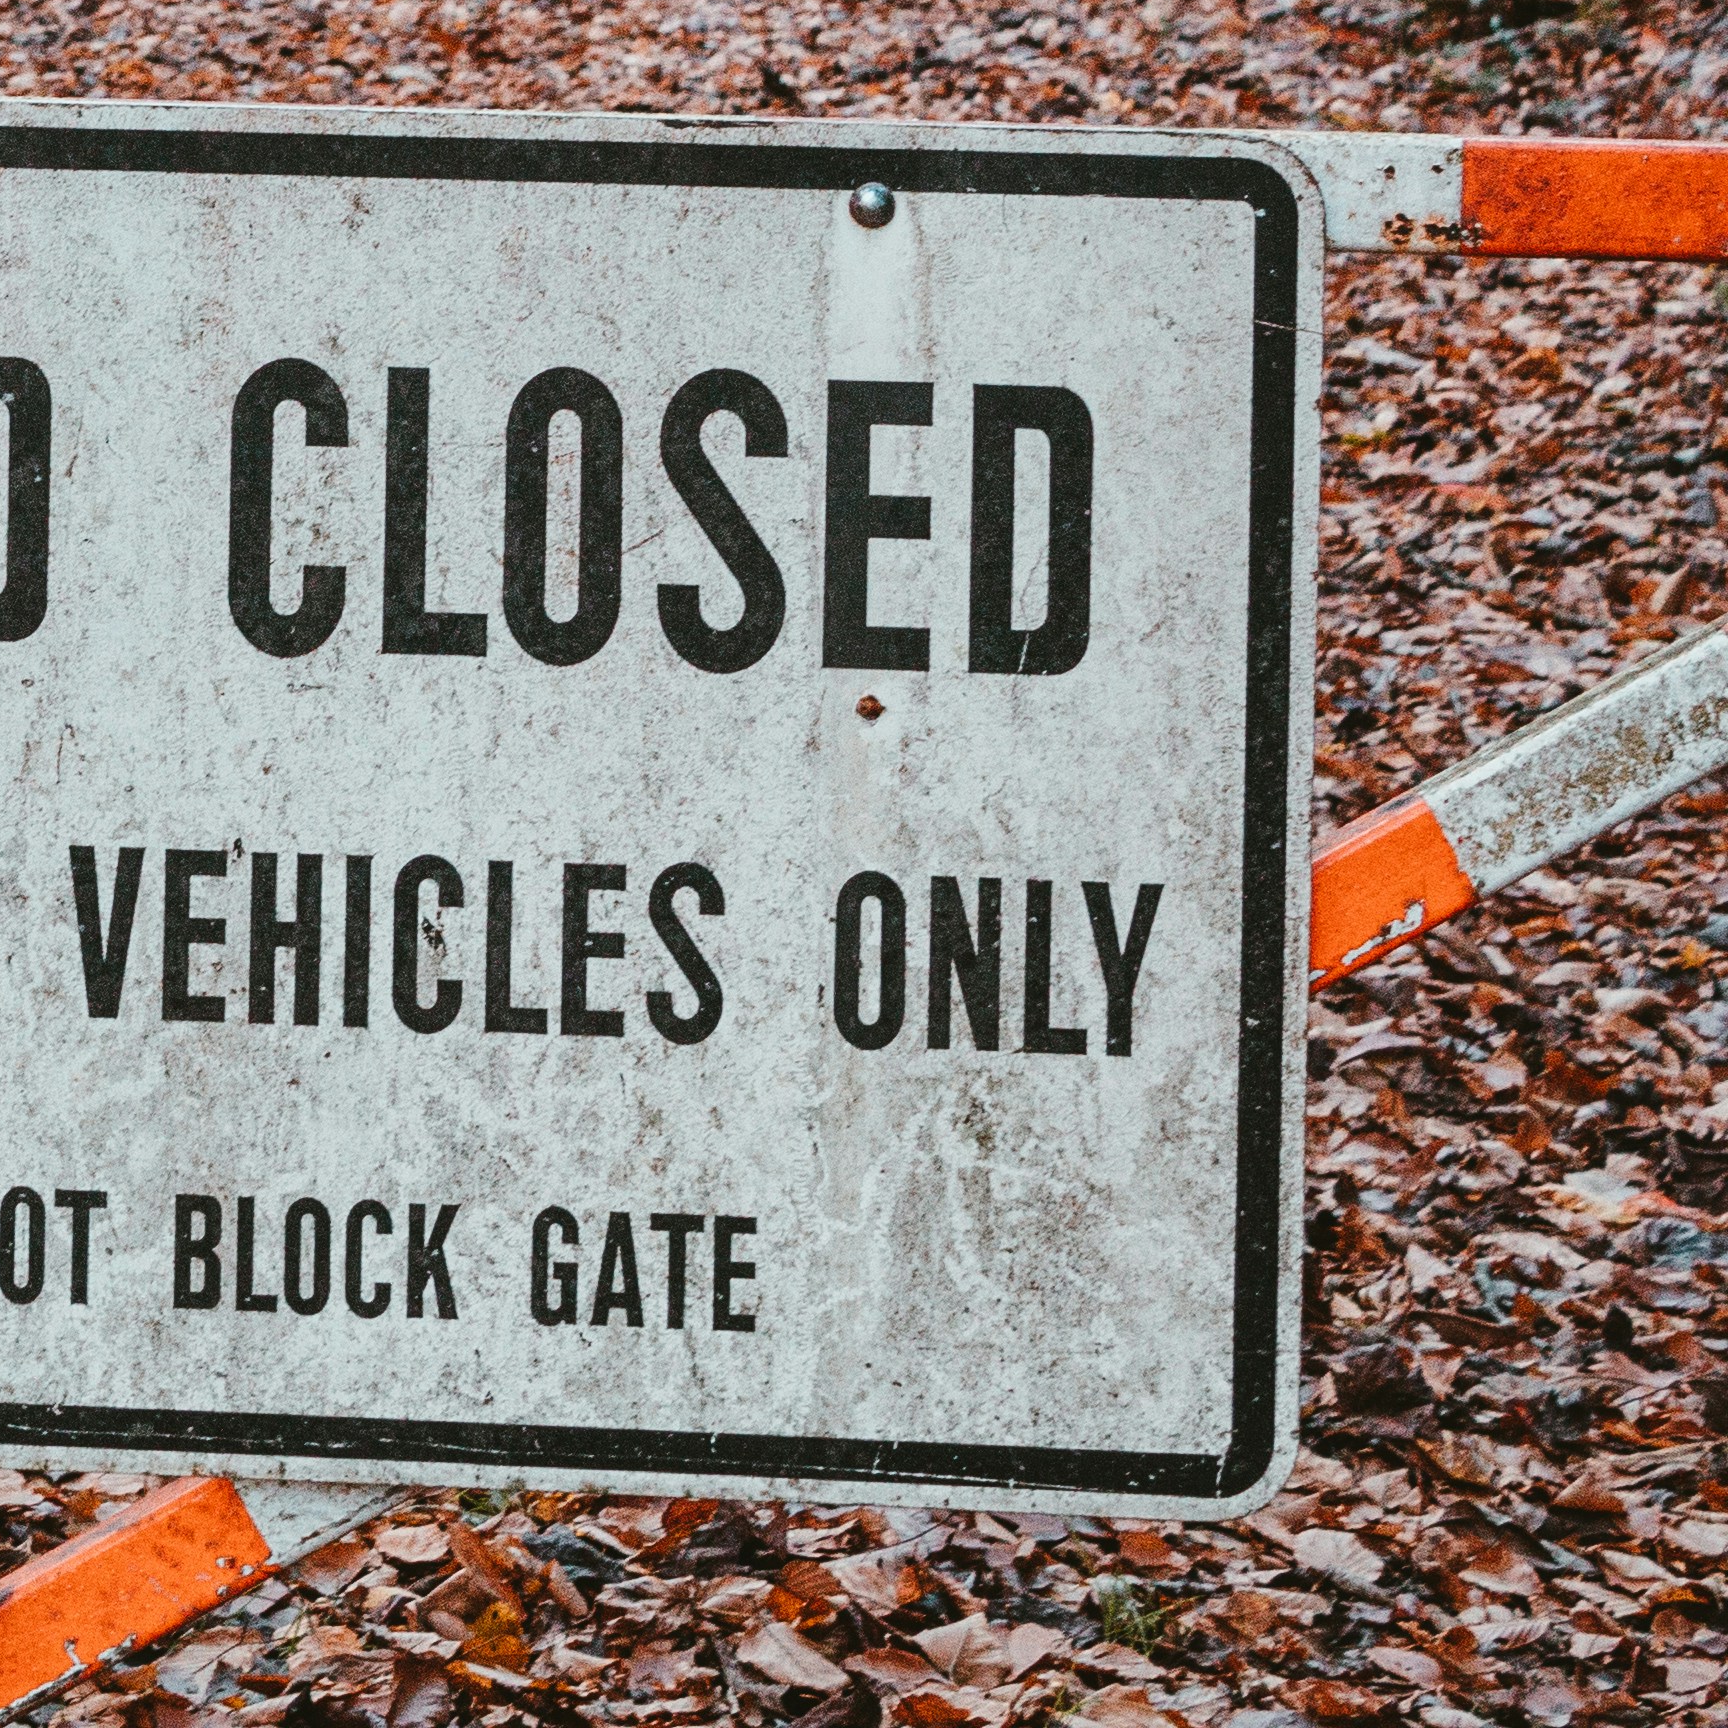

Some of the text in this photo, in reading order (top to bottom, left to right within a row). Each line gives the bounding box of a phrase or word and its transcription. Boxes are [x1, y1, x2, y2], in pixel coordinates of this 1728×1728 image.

[230, 359, 1092, 674] CLOSED
[71, 847, 723, 1043] VEHICLES
[835, 873, 1161, 1055] ONLY
[175, 1195, 457, 1318] BLOCK
[532, 1207, 755, 1331] GATE
